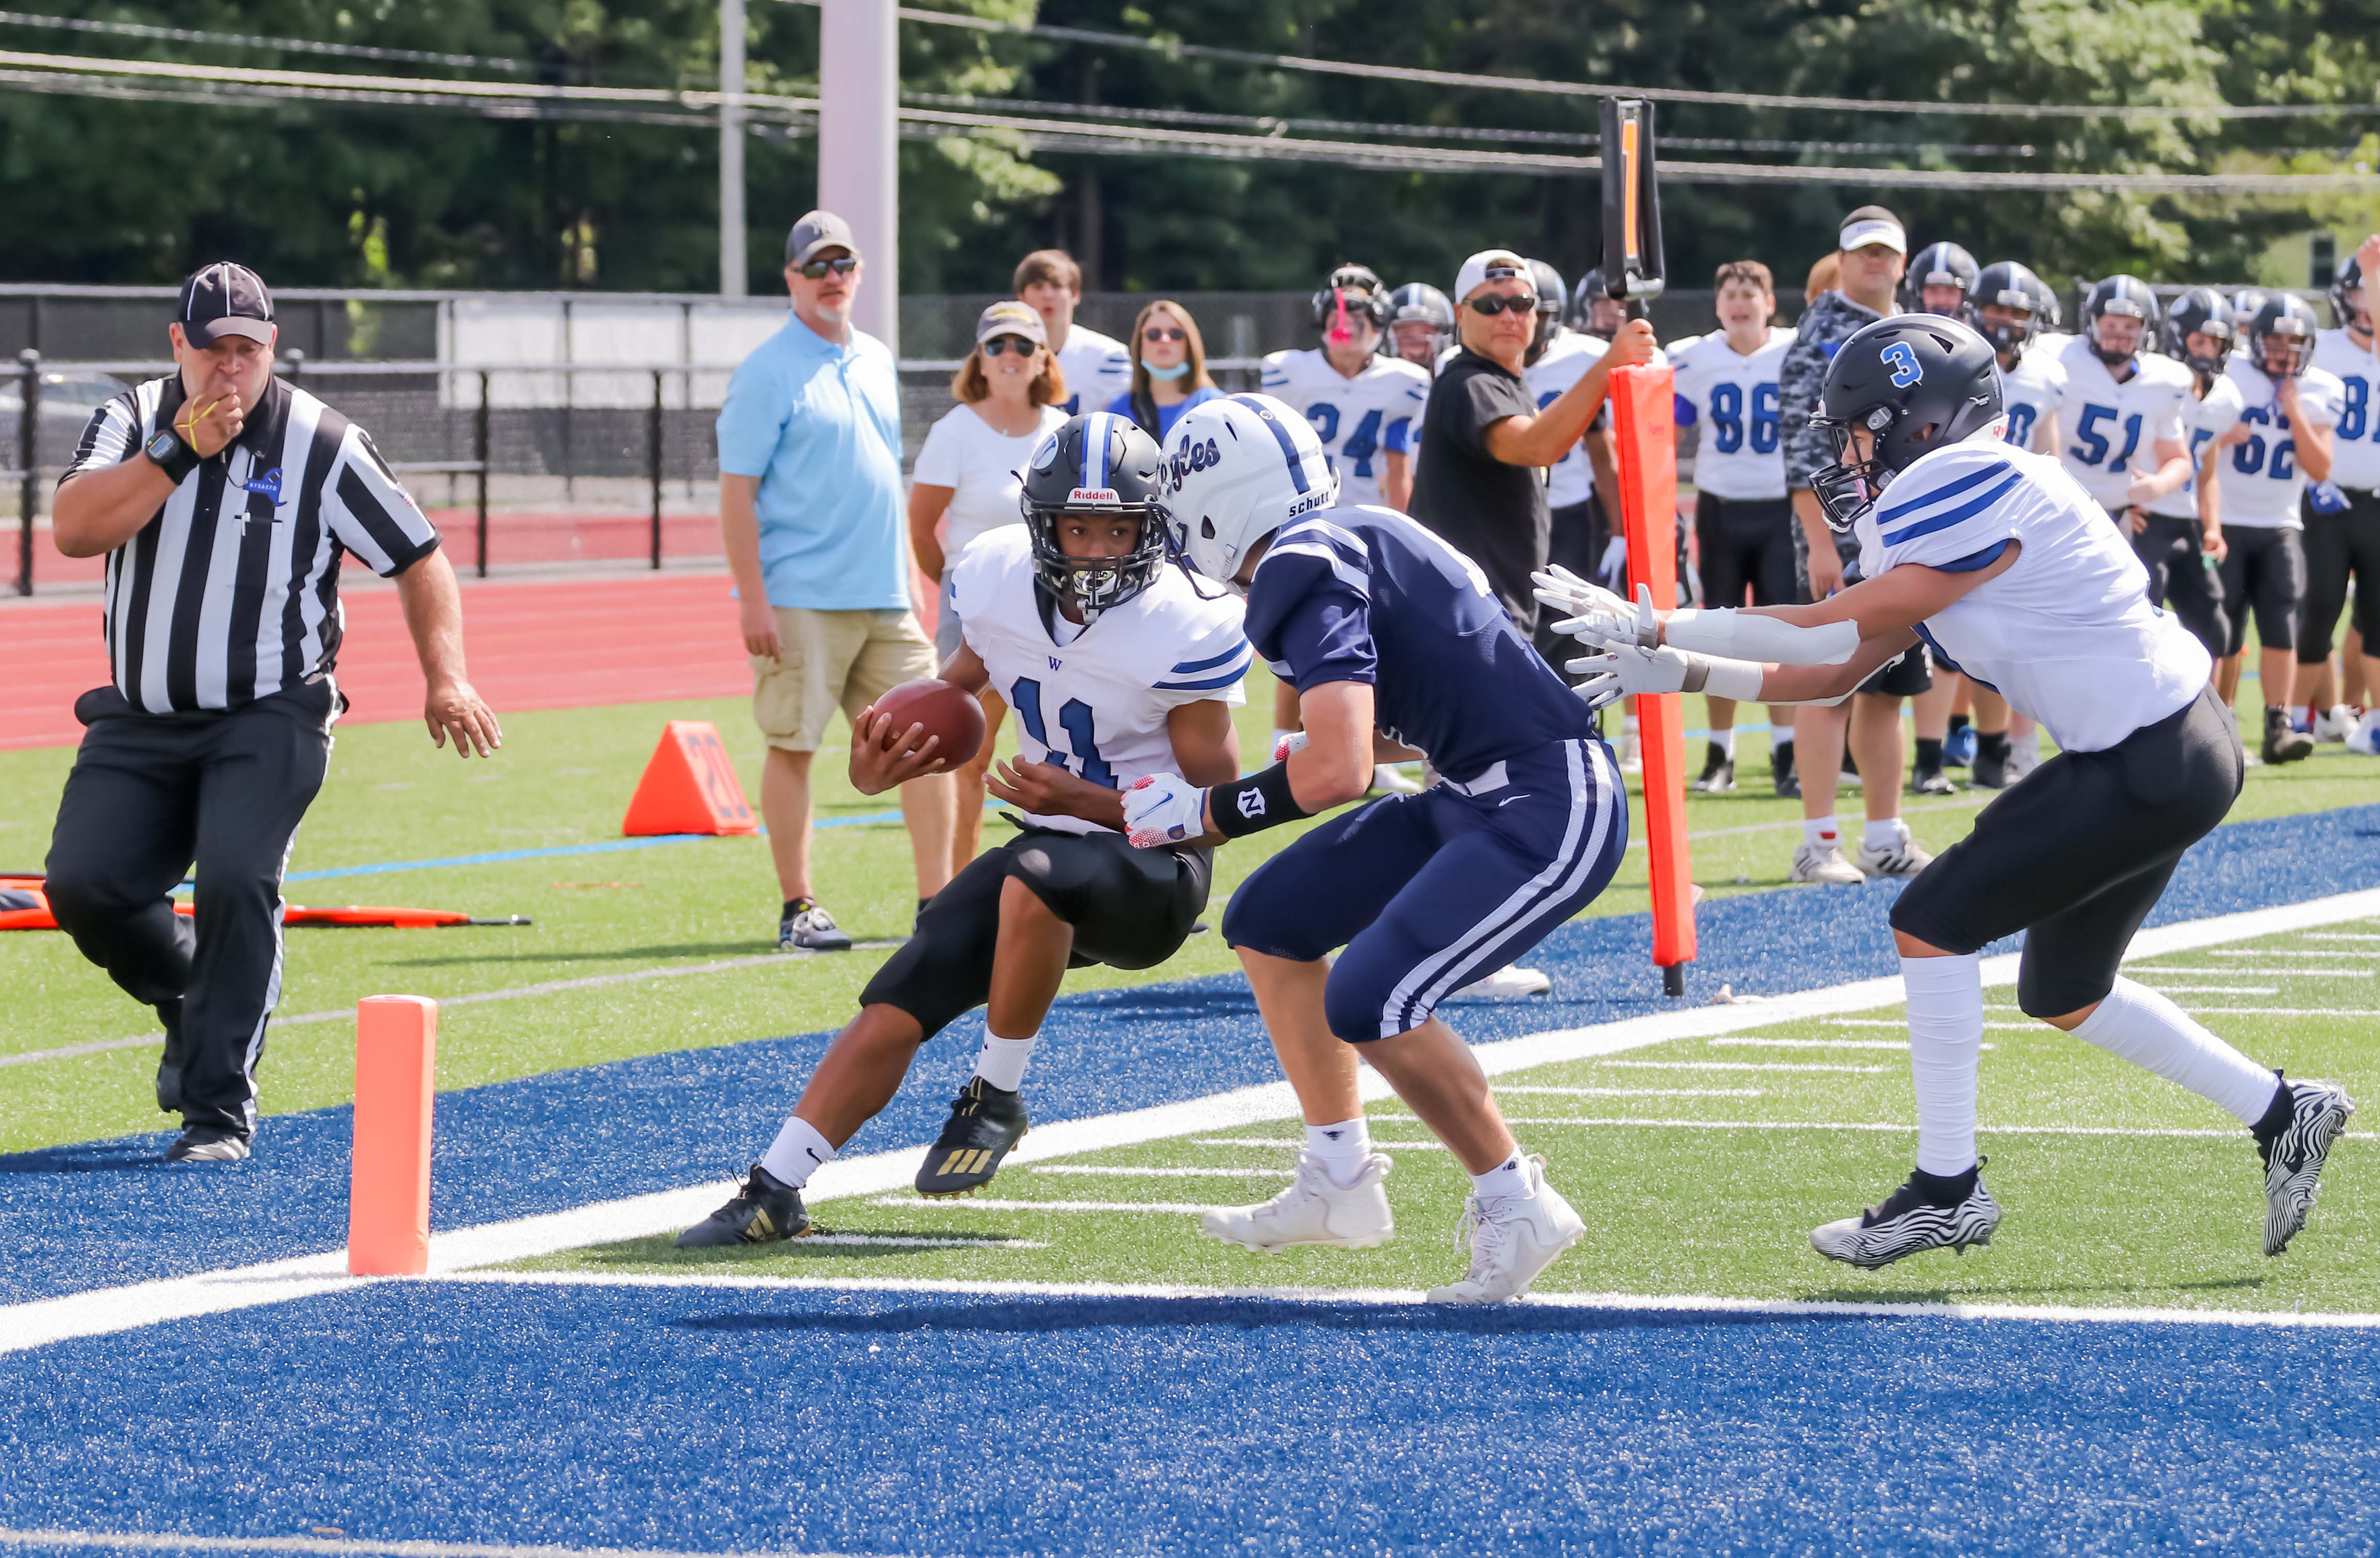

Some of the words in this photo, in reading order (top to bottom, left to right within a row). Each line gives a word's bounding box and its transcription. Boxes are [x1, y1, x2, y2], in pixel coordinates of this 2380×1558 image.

[1880, 341, 1923, 388] 3
[1307, 403, 1383, 477] 24
[1711, 383, 1779, 453] 86
[2069, 403, 2143, 473] 51
[2336, 376, 2380, 442] 8
[1074, 491, 1113, 500] Riddell
[1048, 655, 1062, 671] W
[1010, 676, 1119, 791] 11
